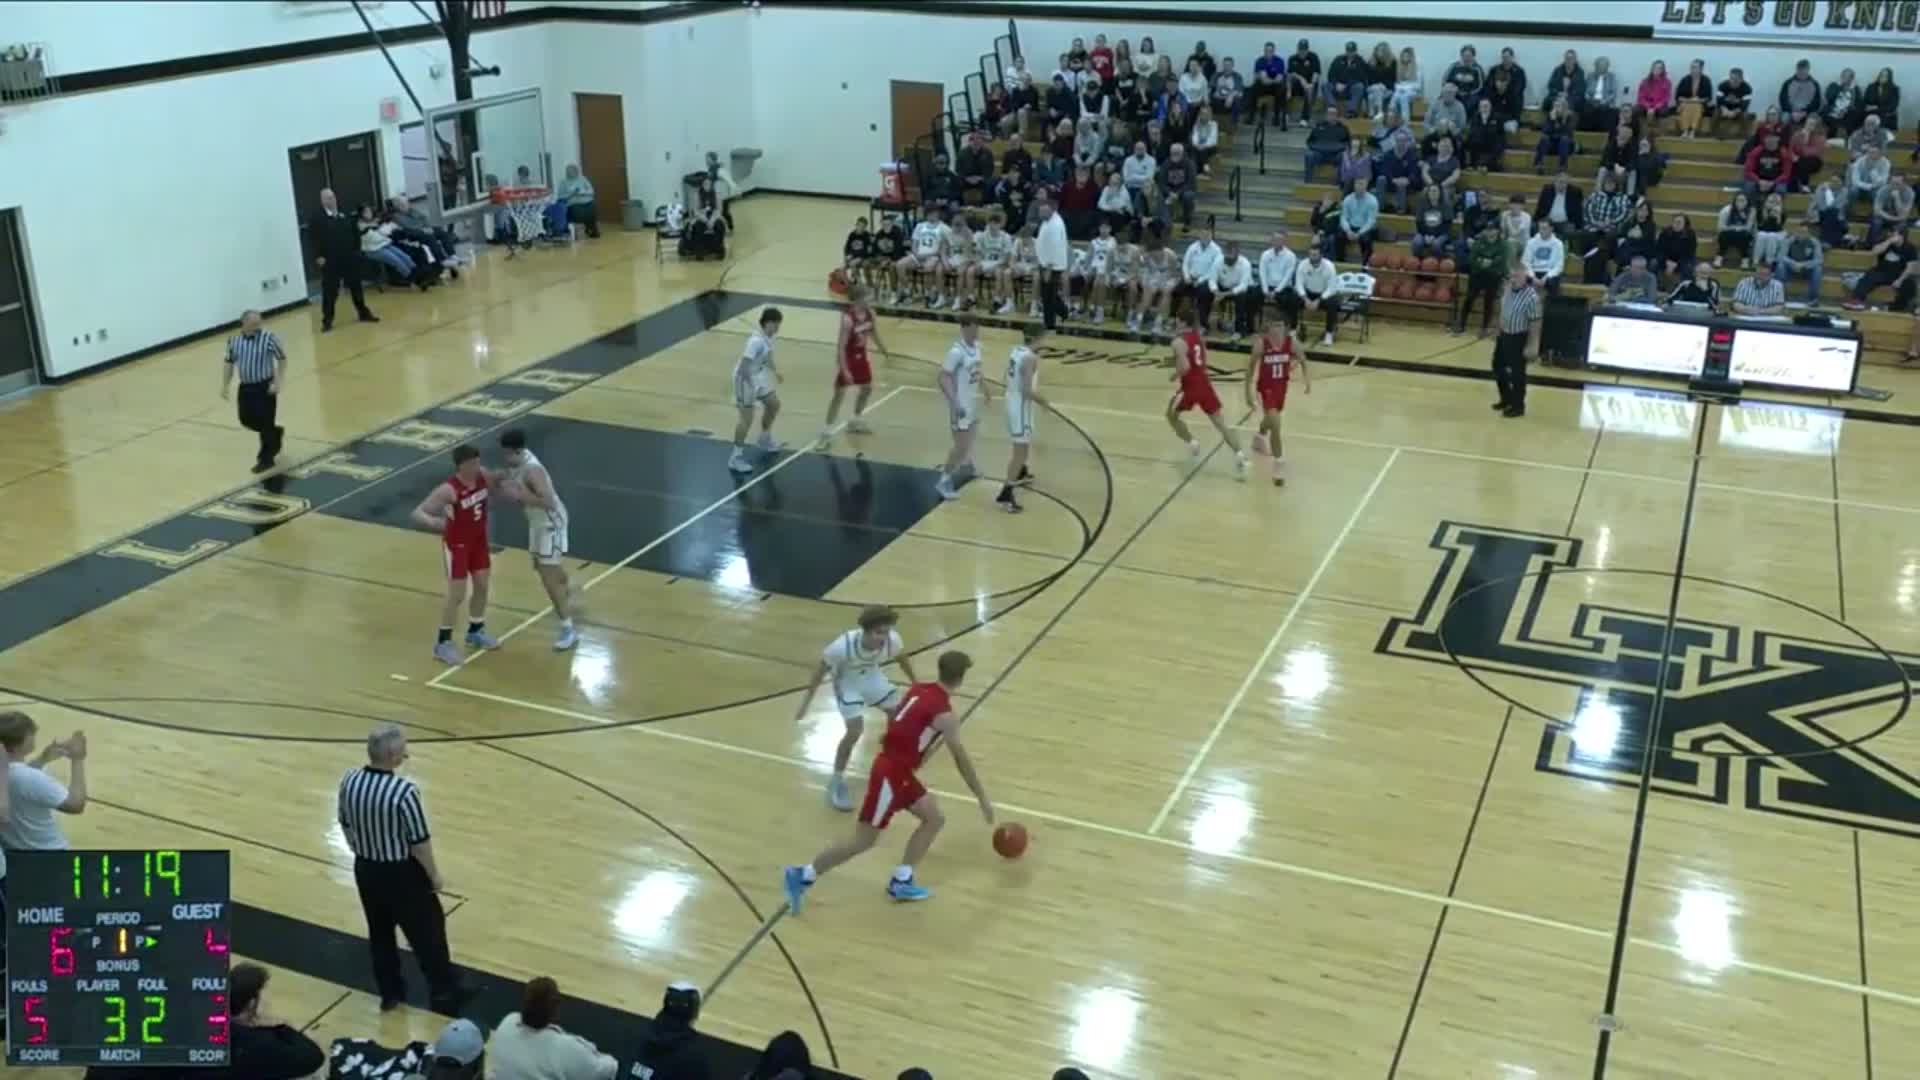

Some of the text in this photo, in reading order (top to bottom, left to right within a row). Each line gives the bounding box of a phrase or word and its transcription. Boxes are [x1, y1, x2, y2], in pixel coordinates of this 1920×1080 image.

[1773, 1, 1817, 28] GO
[1824, 1, 1920, 32] KNIG
[98, 367, 600, 570] LUTHER
